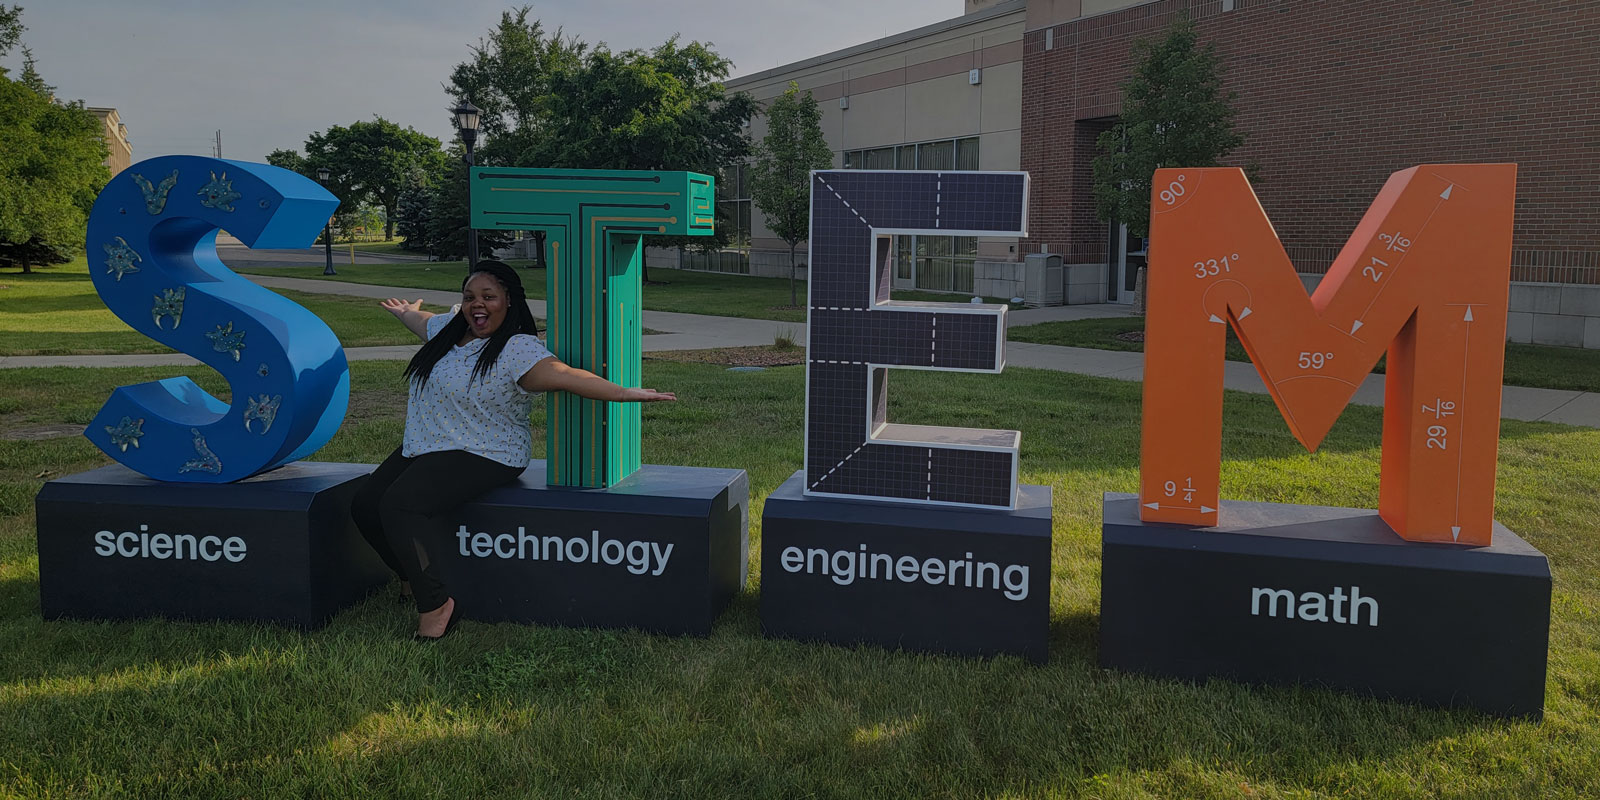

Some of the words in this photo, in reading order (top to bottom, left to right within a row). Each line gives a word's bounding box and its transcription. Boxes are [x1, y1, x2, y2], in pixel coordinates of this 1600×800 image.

[1362, 256, 1388, 282] 21
[1426, 425, 1447, 450] 29
[1164, 480, 1176, 497] 9
[94, 524, 247, 562] science
[456, 525, 674, 576] technology
[781, 543, 1030, 601] engineering
[1251, 586, 1379, 627] math
